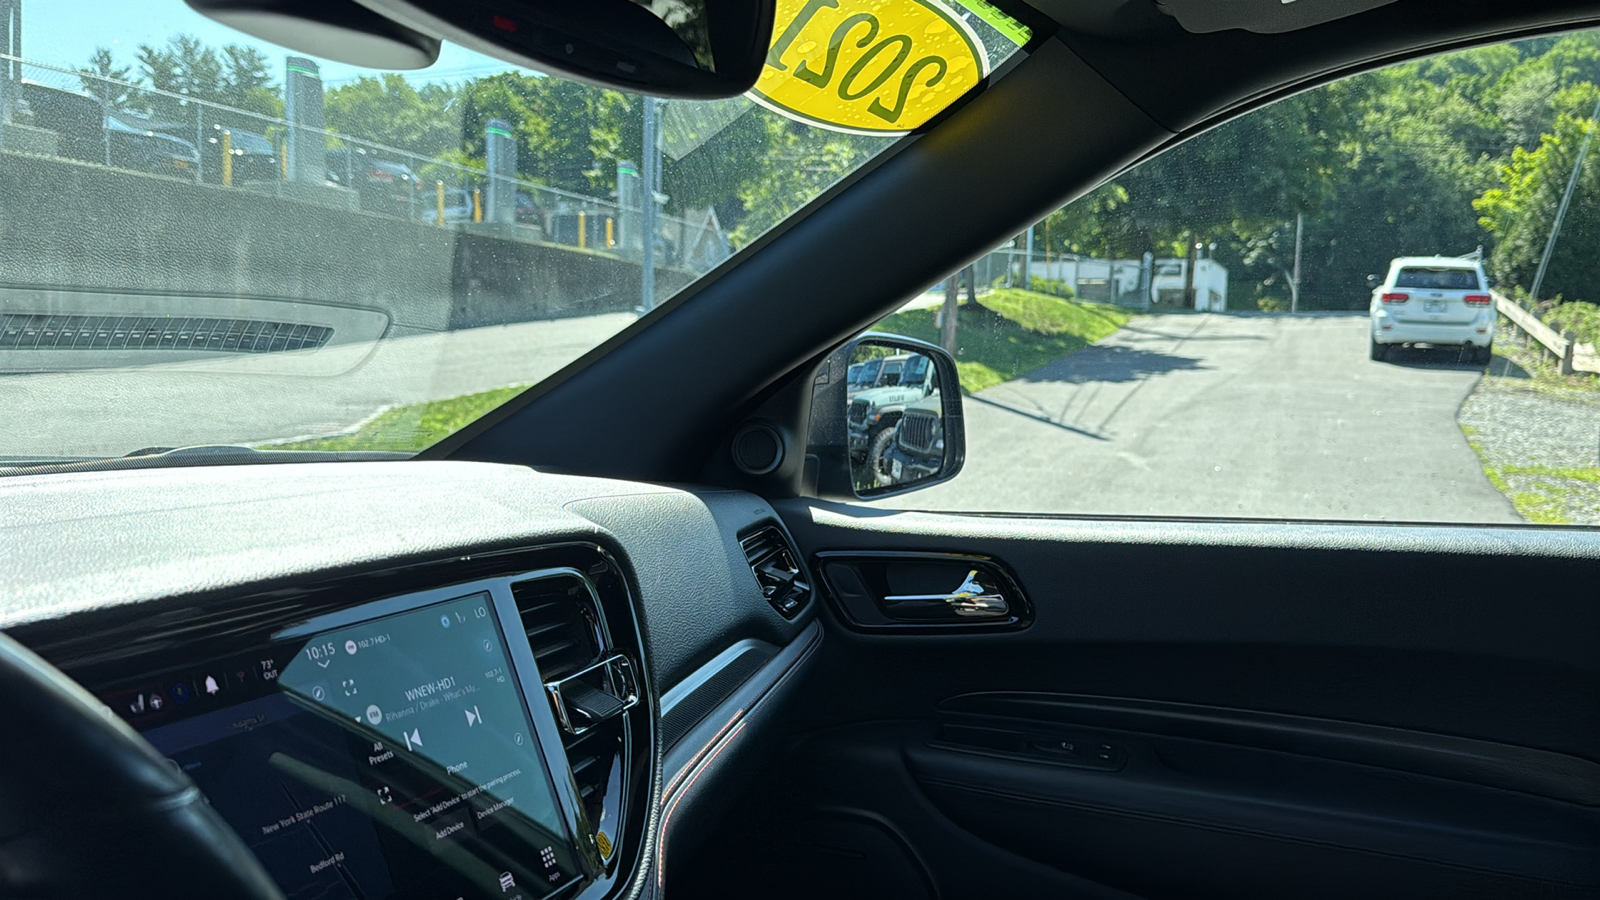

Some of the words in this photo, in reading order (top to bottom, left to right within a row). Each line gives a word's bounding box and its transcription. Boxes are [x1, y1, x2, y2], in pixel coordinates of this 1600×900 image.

[474, 606, 486, 619] LO
[305, 642, 336, 661] 10:15
[263, 670, 278, 680] OUT
[496, 675, 505, 683] HD
[404, 676, 456, 702] WNEW-HD1
[385, 706, 415, 722] Rihanna
[419, 697, 440, 711] Drake
[374, 741, 384, 752] All
[368, 751, 394, 765] Presets
[446, 761, 468, 775] Phone
[413, 810, 431, 822] Select
[461, 792, 468, 800] to
[467, 786, 480, 797] start
[478, 782, 488, 792] the
[486, 776, 504, 790] pairing
[476, 807, 494, 820] Device
[493, 796, 514, 811] Manager
[262, 823, 279, 835] New
[279, 815, 296, 828] York
[295, 809, 314, 822] State
[313, 801, 334, 814] Route
[435, 827, 447, 840] Add
[447, 821, 465, 834] Device
[310, 856, 335, 874] Bedford
[335, 851, 345, 862] Rd
